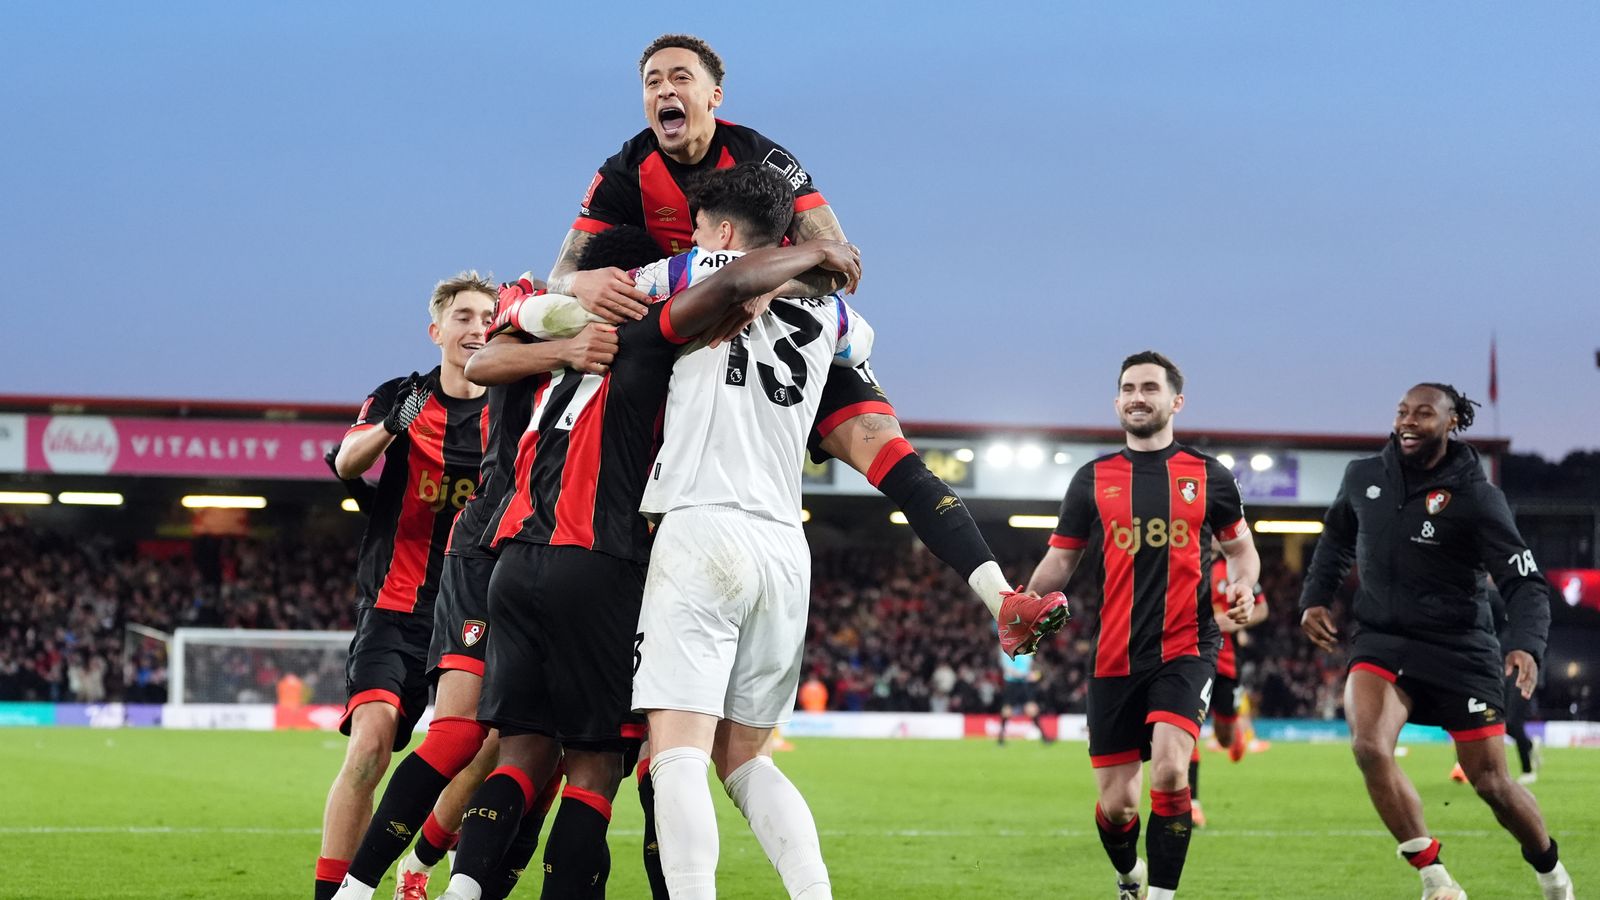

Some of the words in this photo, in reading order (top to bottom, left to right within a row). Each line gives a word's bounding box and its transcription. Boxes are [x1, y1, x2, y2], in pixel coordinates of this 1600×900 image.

[130, 435, 280, 460] VITALITY
[301, 439, 342, 462] ST
[418, 470, 475, 512] bj8
[1111, 517, 1189, 555] bj88
